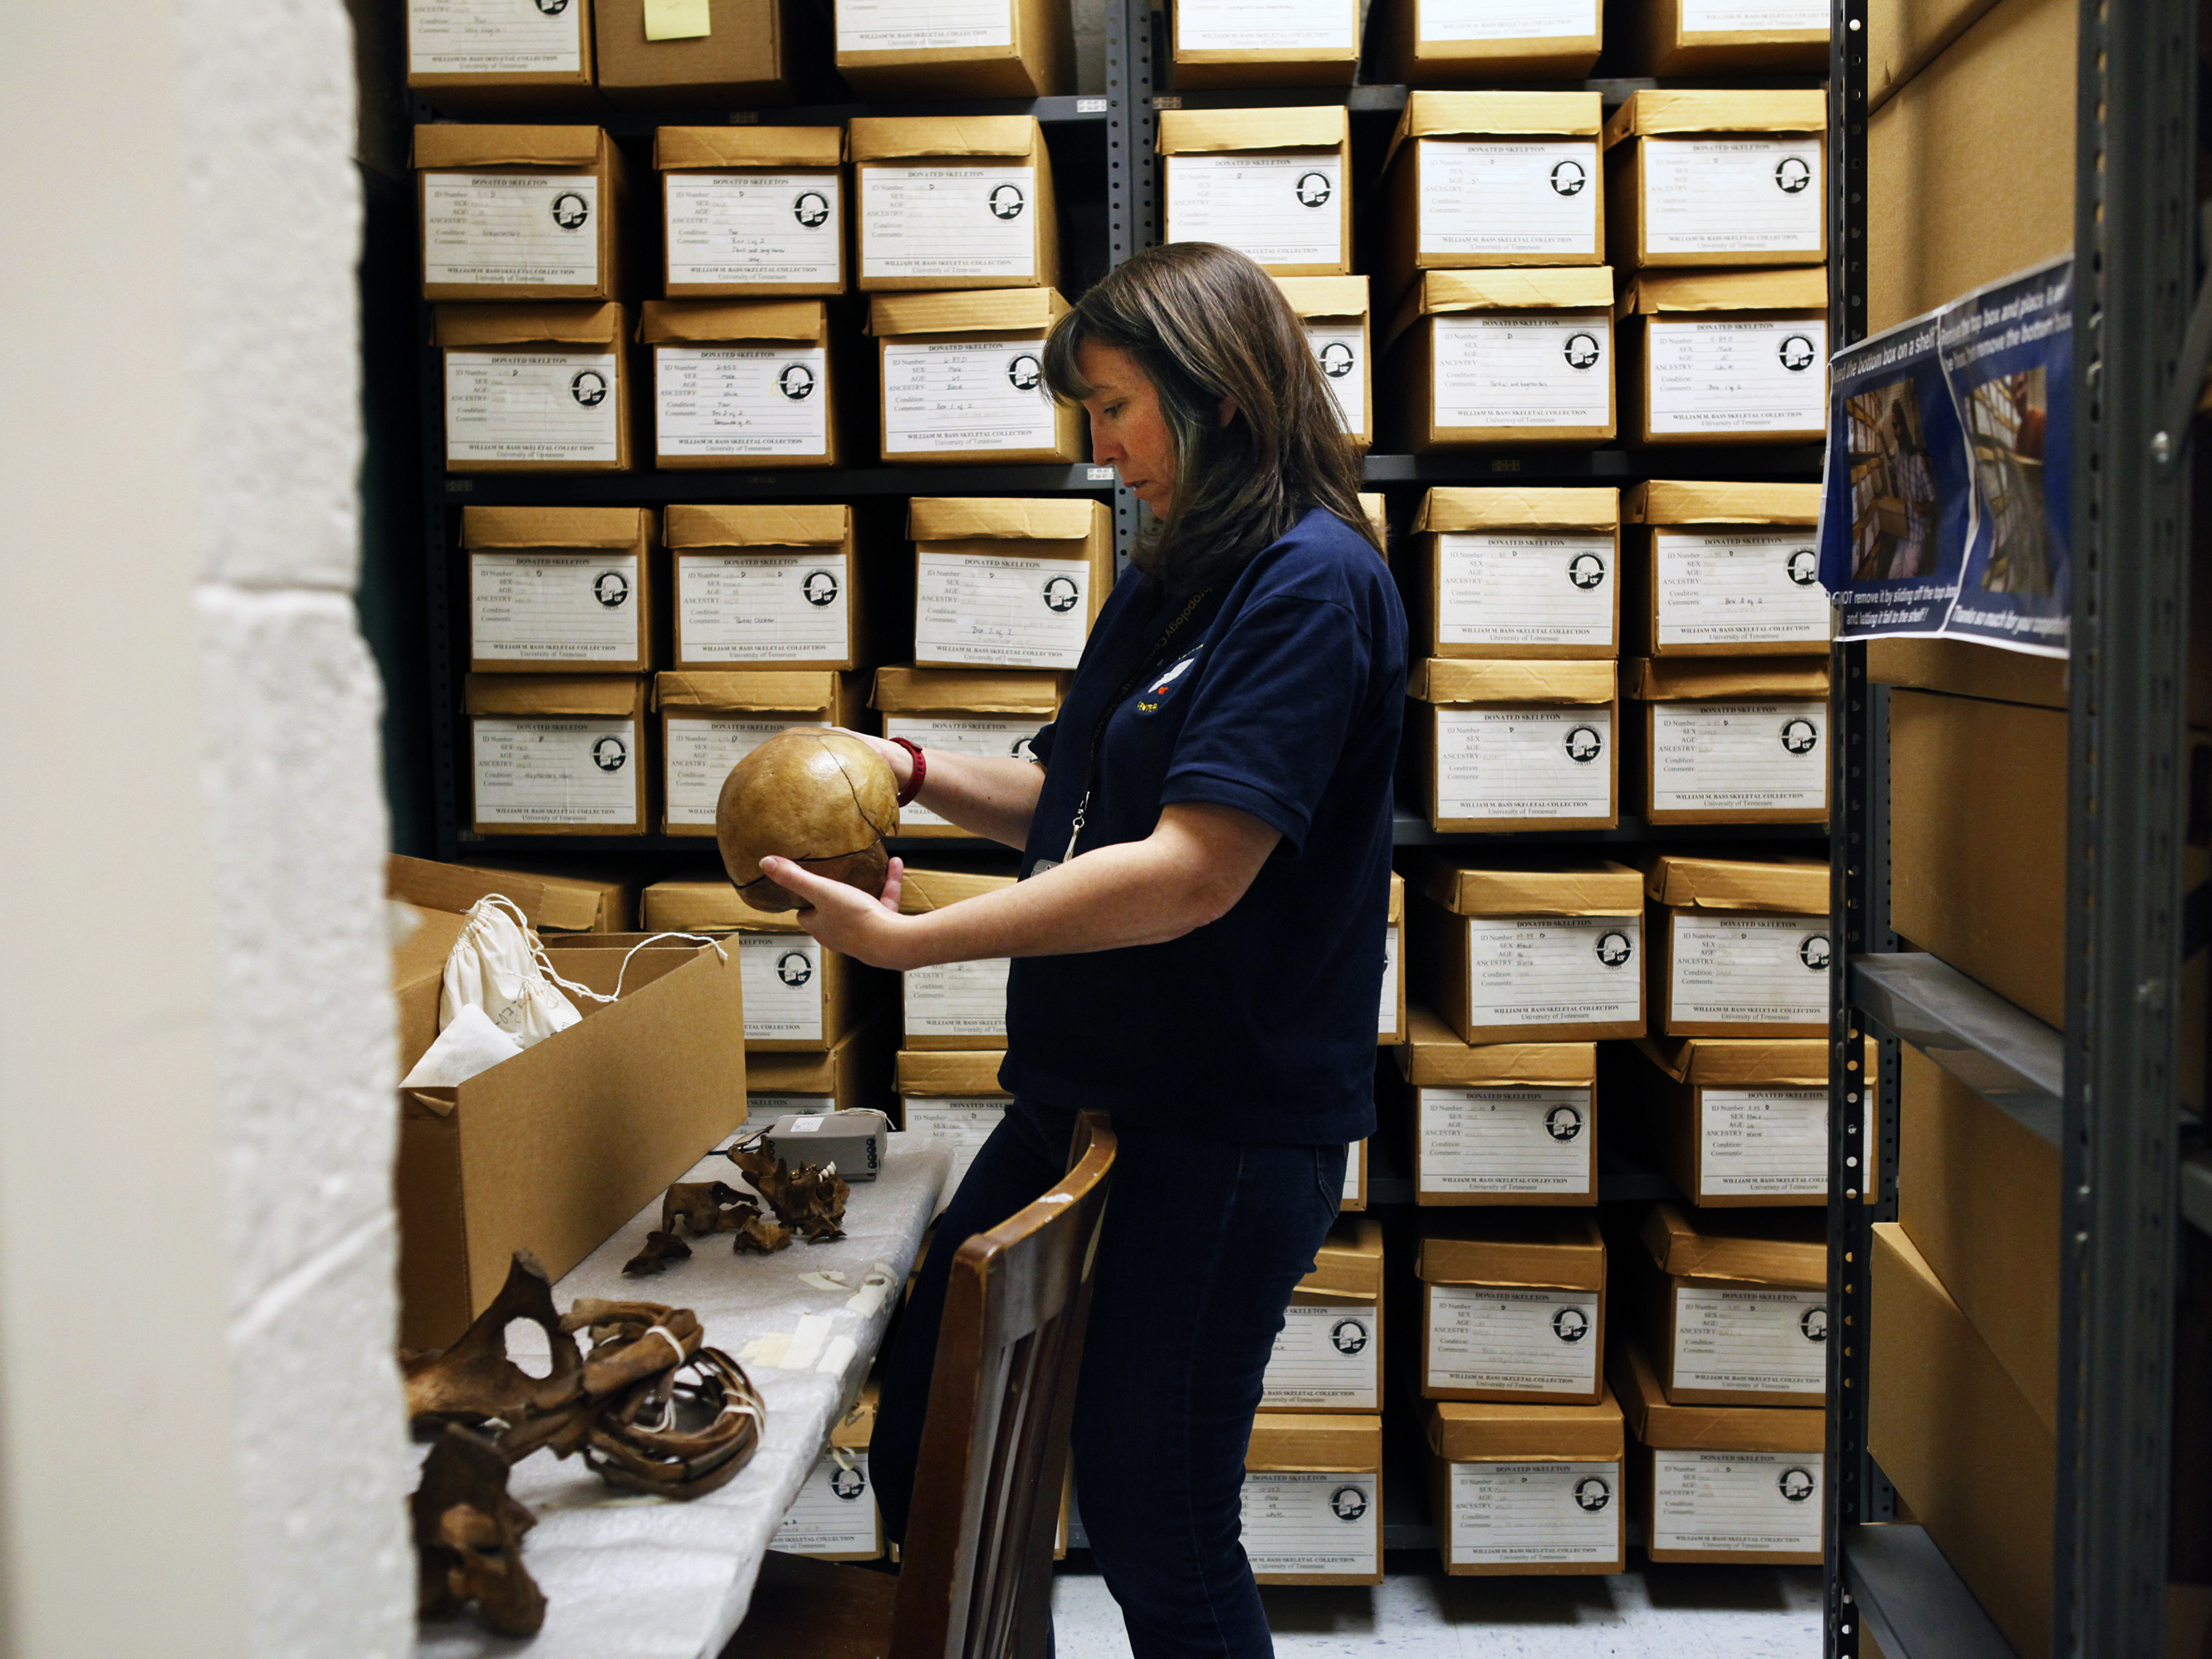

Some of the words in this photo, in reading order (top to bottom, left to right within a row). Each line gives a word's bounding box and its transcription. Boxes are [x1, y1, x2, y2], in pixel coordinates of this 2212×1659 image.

[1857, 353, 1883, 374] bottom
[1882, 346, 1897, 365] box
[1897, 341, 1909, 360] on
[1908, 340, 1915, 356] a
[1853, 592, 1878, 604] remove
[1885, 589, 1894, 606] by
[1893, 587, 1914, 605] sliding
[1846, 612, 1858, 625] and
